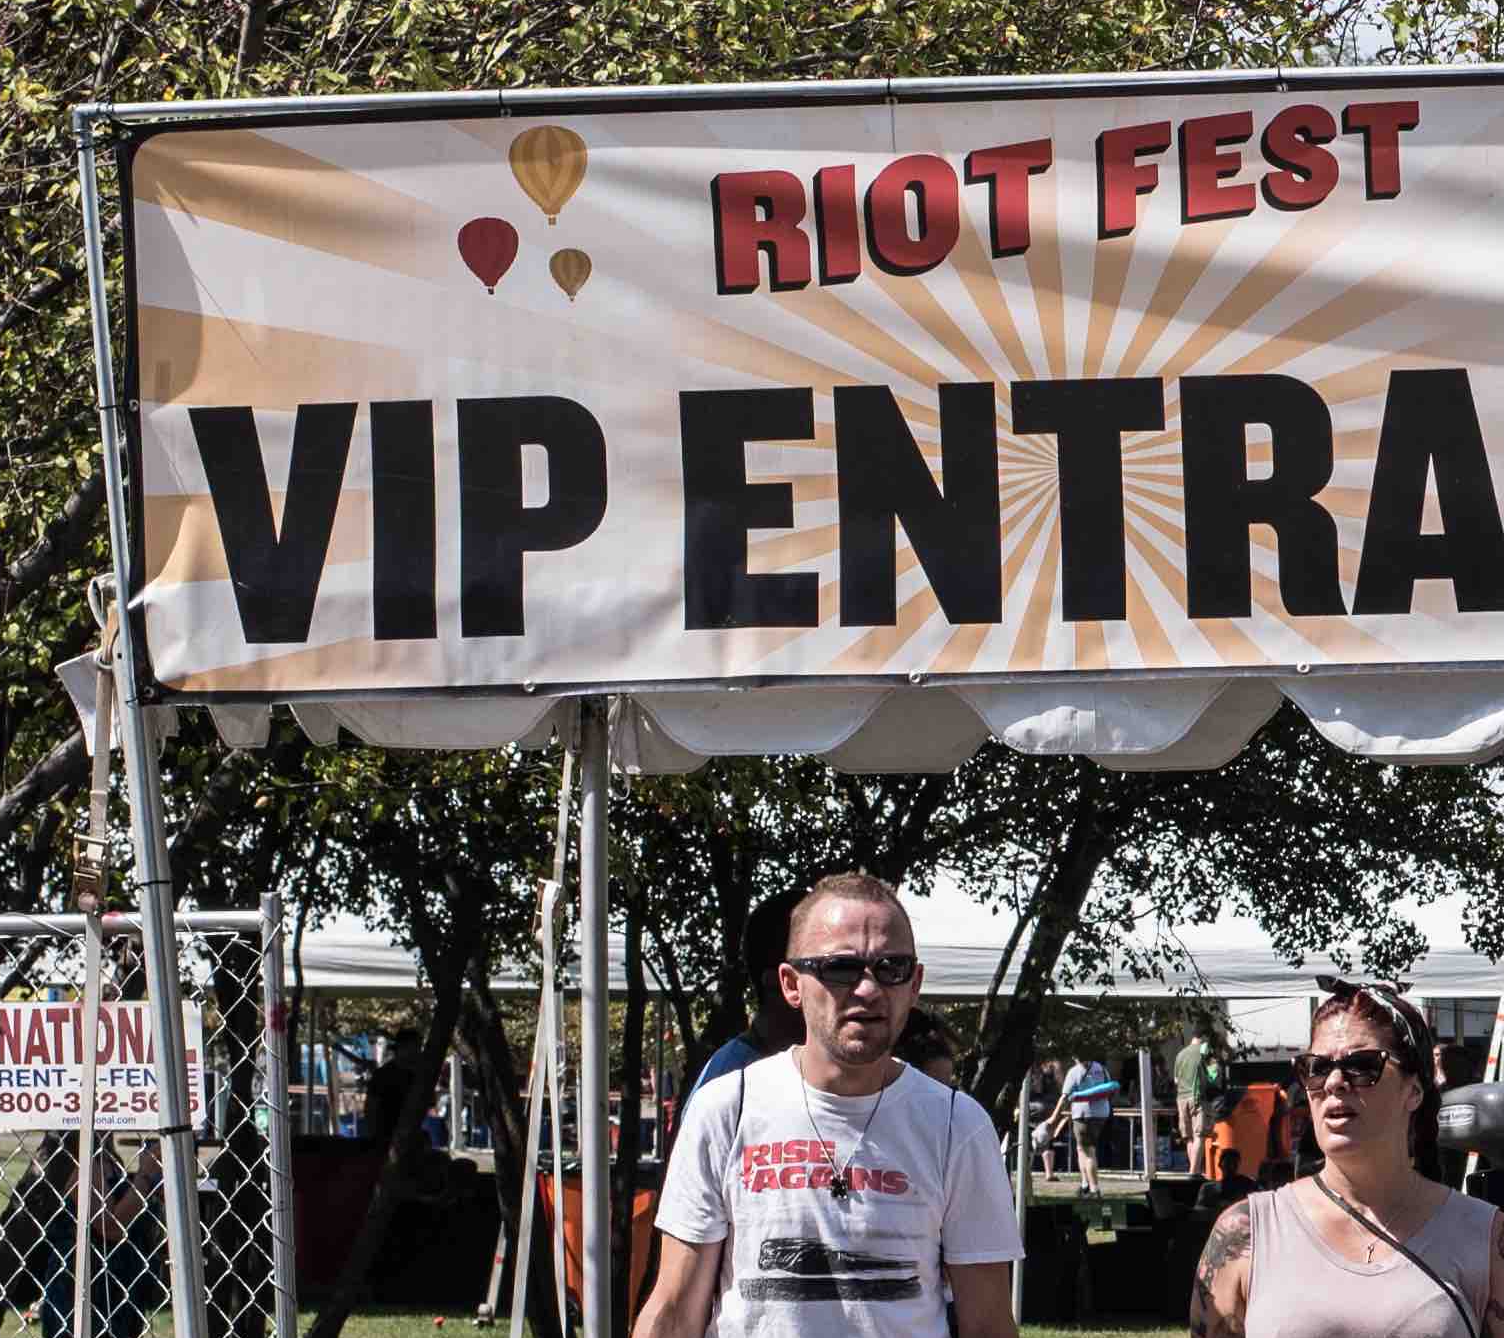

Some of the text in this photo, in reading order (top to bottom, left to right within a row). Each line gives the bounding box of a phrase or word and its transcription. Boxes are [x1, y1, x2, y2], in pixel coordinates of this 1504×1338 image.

[710, 100, 1420, 296] RIOT FEST
[192, 396, 608, 643] VIP
[0, 1092, 199, 1112] 800-32-565
[62, 1116, 136, 1125] rentonal.com
[742, 1140, 836, 1169] RISE
